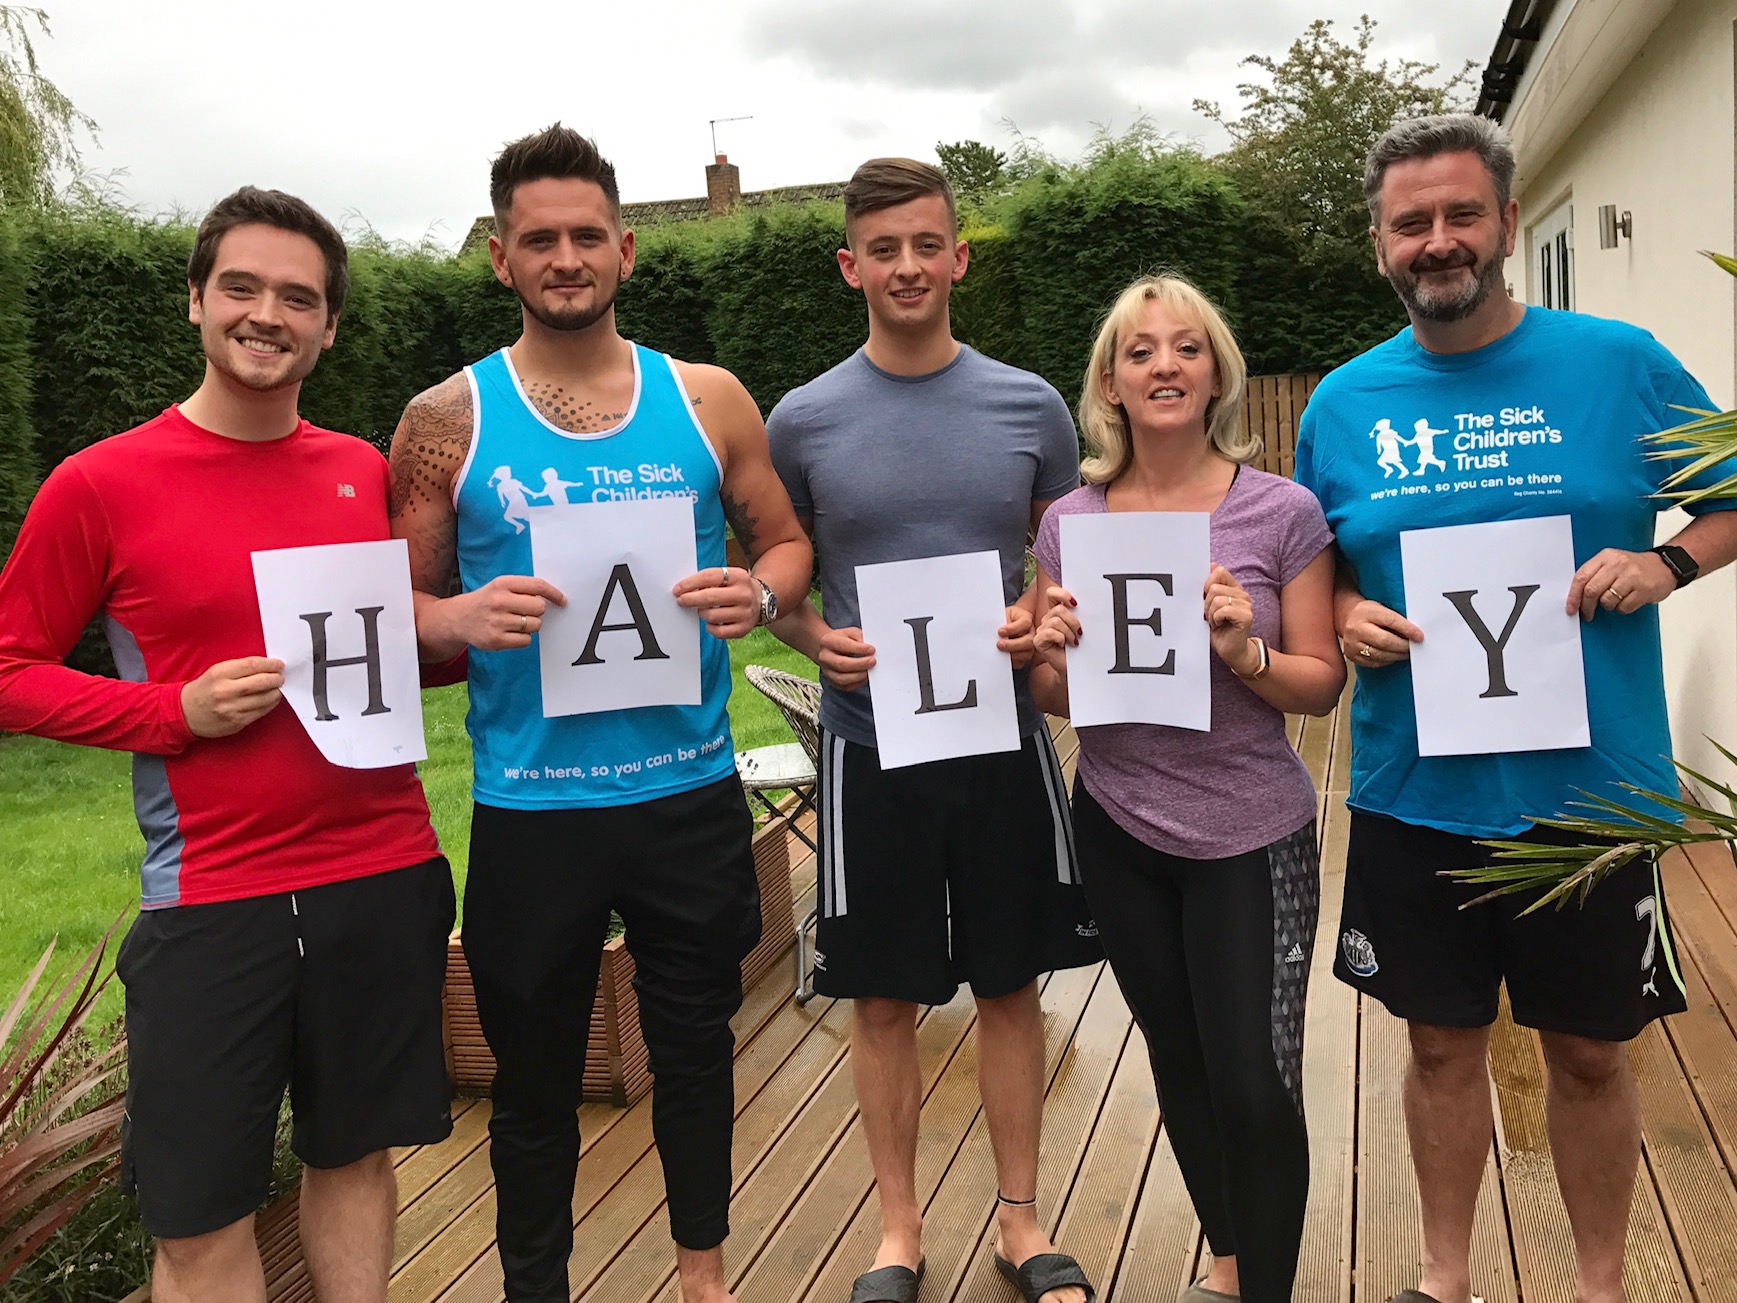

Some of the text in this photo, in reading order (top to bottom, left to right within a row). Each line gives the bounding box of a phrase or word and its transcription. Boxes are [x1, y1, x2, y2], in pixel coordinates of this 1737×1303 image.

[1453, 406, 1545, 432] The Sick
[1453, 426, 1562, 451] Children's
[586, 463, 684, 485] The Sick
[1370, 473, 1562, 501] we're here, so you can be there
[1453, 450, 1509, 471] Trust
[571, 563, 671, 667] A
[1102, 573, 1176, 676] E
[1442, 584, 1541, 699] Y
[299, 606, 392, 722] H
[904, 616, 978, 715] L
[504, 734, 725, 780] we're here, so you can be there
[1634, 895, 1657, 972] 7
